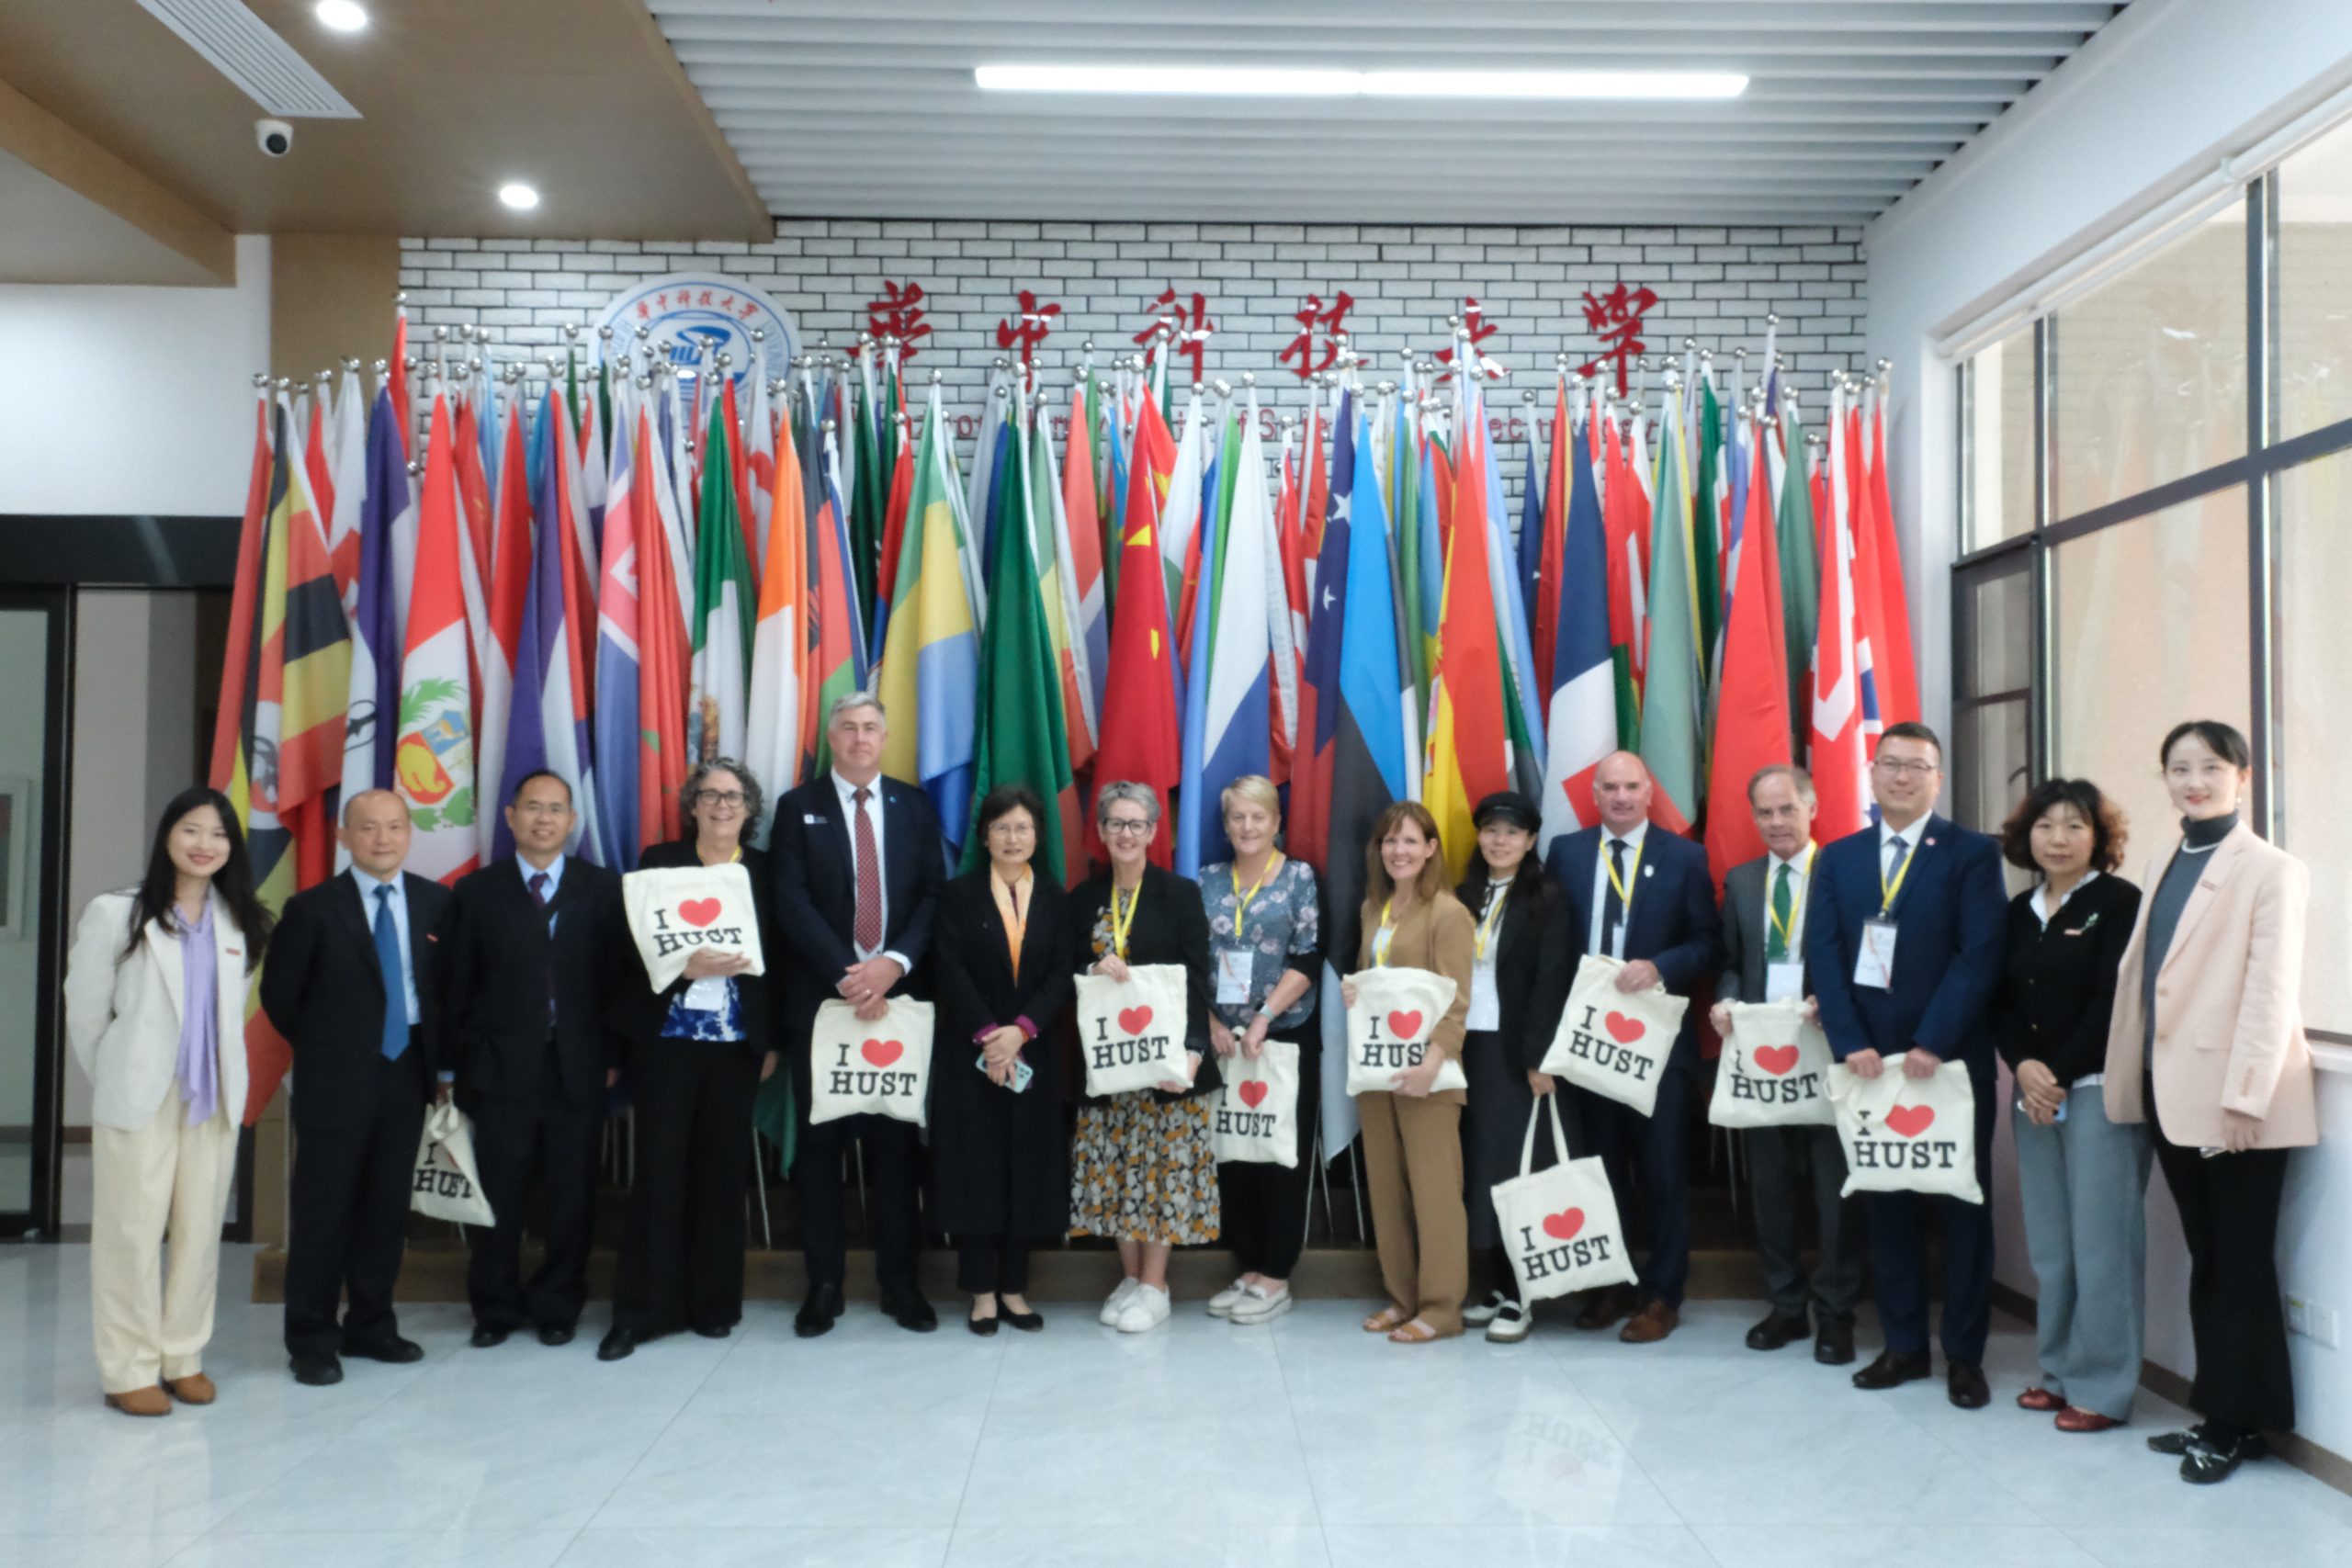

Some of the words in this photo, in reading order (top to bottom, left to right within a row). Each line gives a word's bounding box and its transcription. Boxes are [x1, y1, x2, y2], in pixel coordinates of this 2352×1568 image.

[654, 908, 669, 930] I
[652, 928, 742, 957] HUST
[1096, 1017, 1108, 1041] I
[1369, 1016, 1380, 1039] I
[1580, 1005, 1597, 1030] I
[836, 1043, 850, 1066] I
[1092, 1036, 1170, 1069] HUST
[1360, 1040, 1430, 1067] HUS
[1568, 1030, 1653, 1081] HUST
[829, 1071, 917, 1097] HUST
[1220, 1084, 1228, 1106] I
[1731, 1073, 1818, 1103] HUST
[1216, 1111, 1276, 1137] HUST
[424, 1142, 438, 1165] I
[1853, 1141, 1956, 1169] HUST
[1521, 1226, 1536, 1251] I
[1521, 1235, 1611, 1281] HUST
